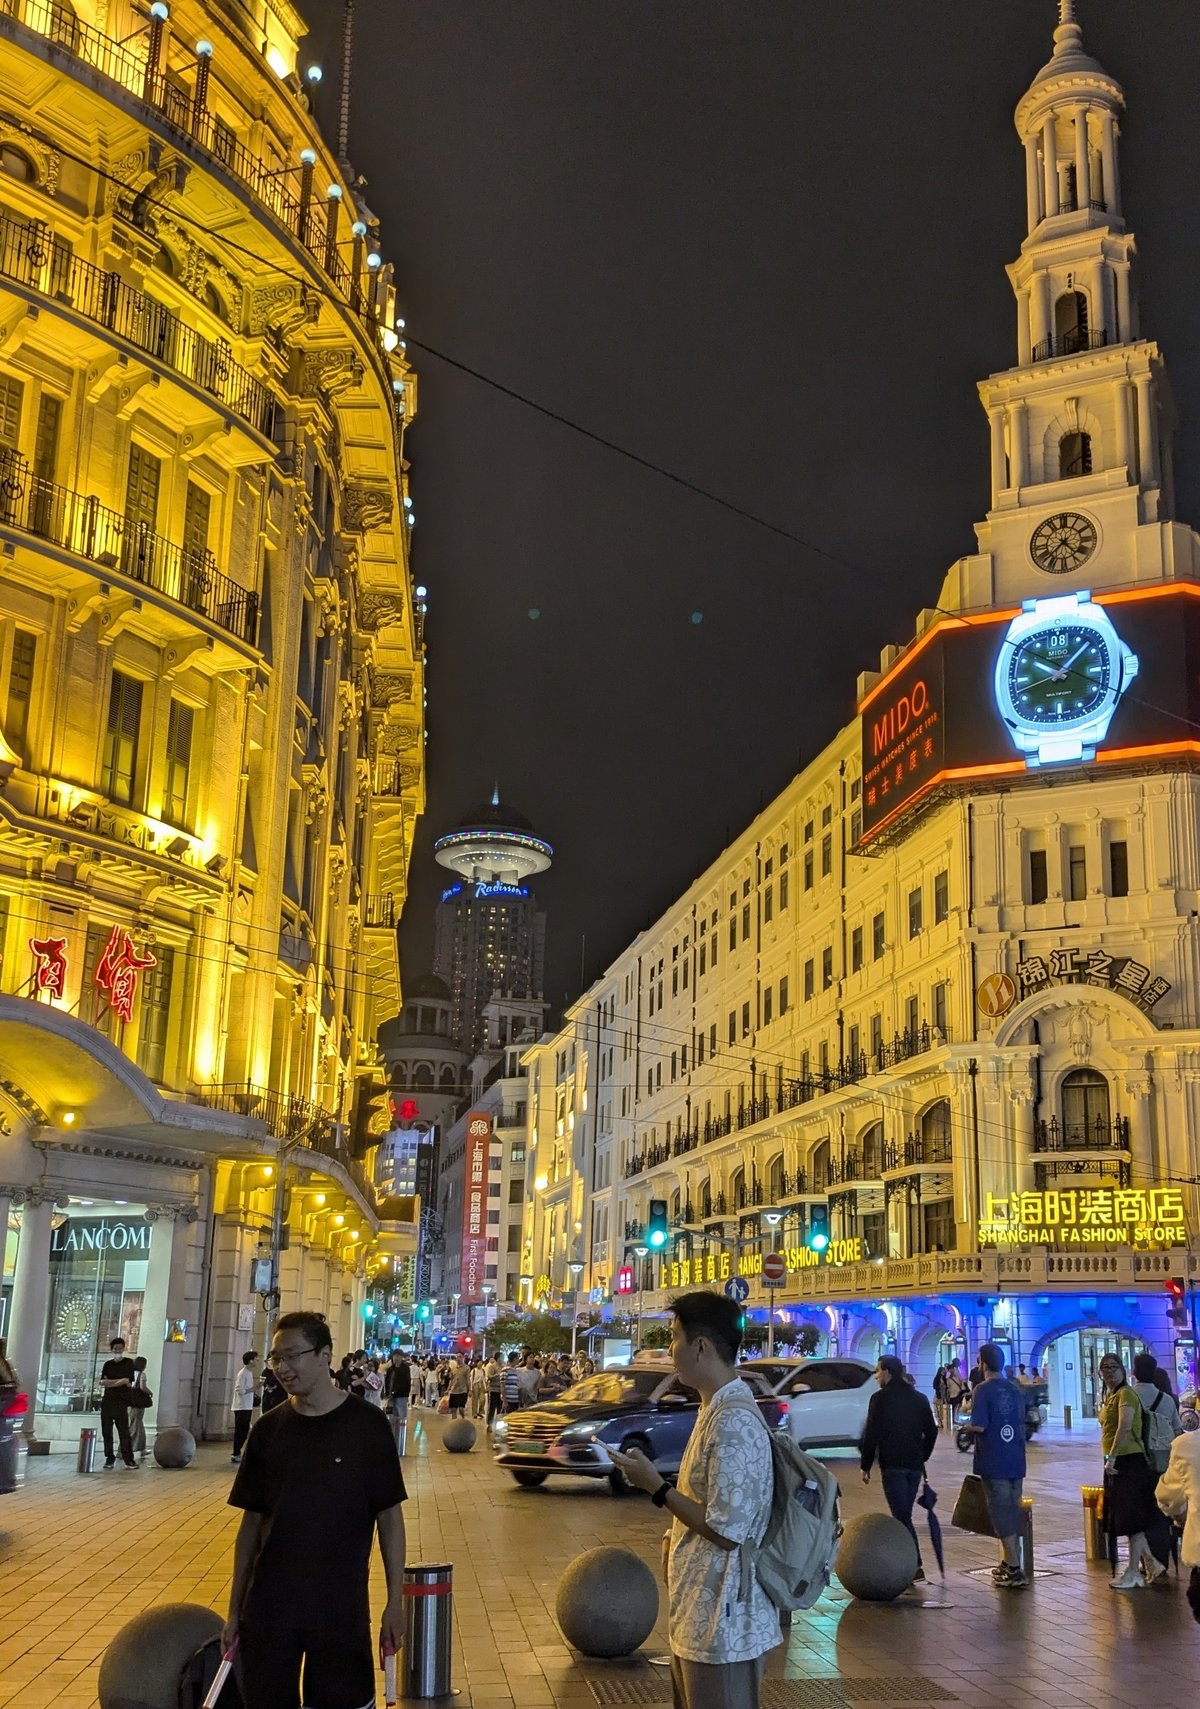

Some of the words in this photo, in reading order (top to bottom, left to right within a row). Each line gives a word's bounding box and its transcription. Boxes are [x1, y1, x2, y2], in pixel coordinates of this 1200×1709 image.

[1048, 649, 1068, 657] MIDO
[1050, 634, 1066, 647] 08
[873, 680, 926, 756] MIDO
[864, 764, 881, 784] SWISS
[906, 724, 923, 746] SINCE
[475, 880, 522, 898] Radisson
[1016, 948, 1150, 994] 锦江之星
[978, 1188, 1184, 1225] 上海时装商店
[978, 1229, 1054, 1243] SHANGHAI
[1061, 1228, 1126, 1242] FASHION
[1134, 1226, 1186, 1241] STORE
[826, 1237, 861, 1264] STORE
